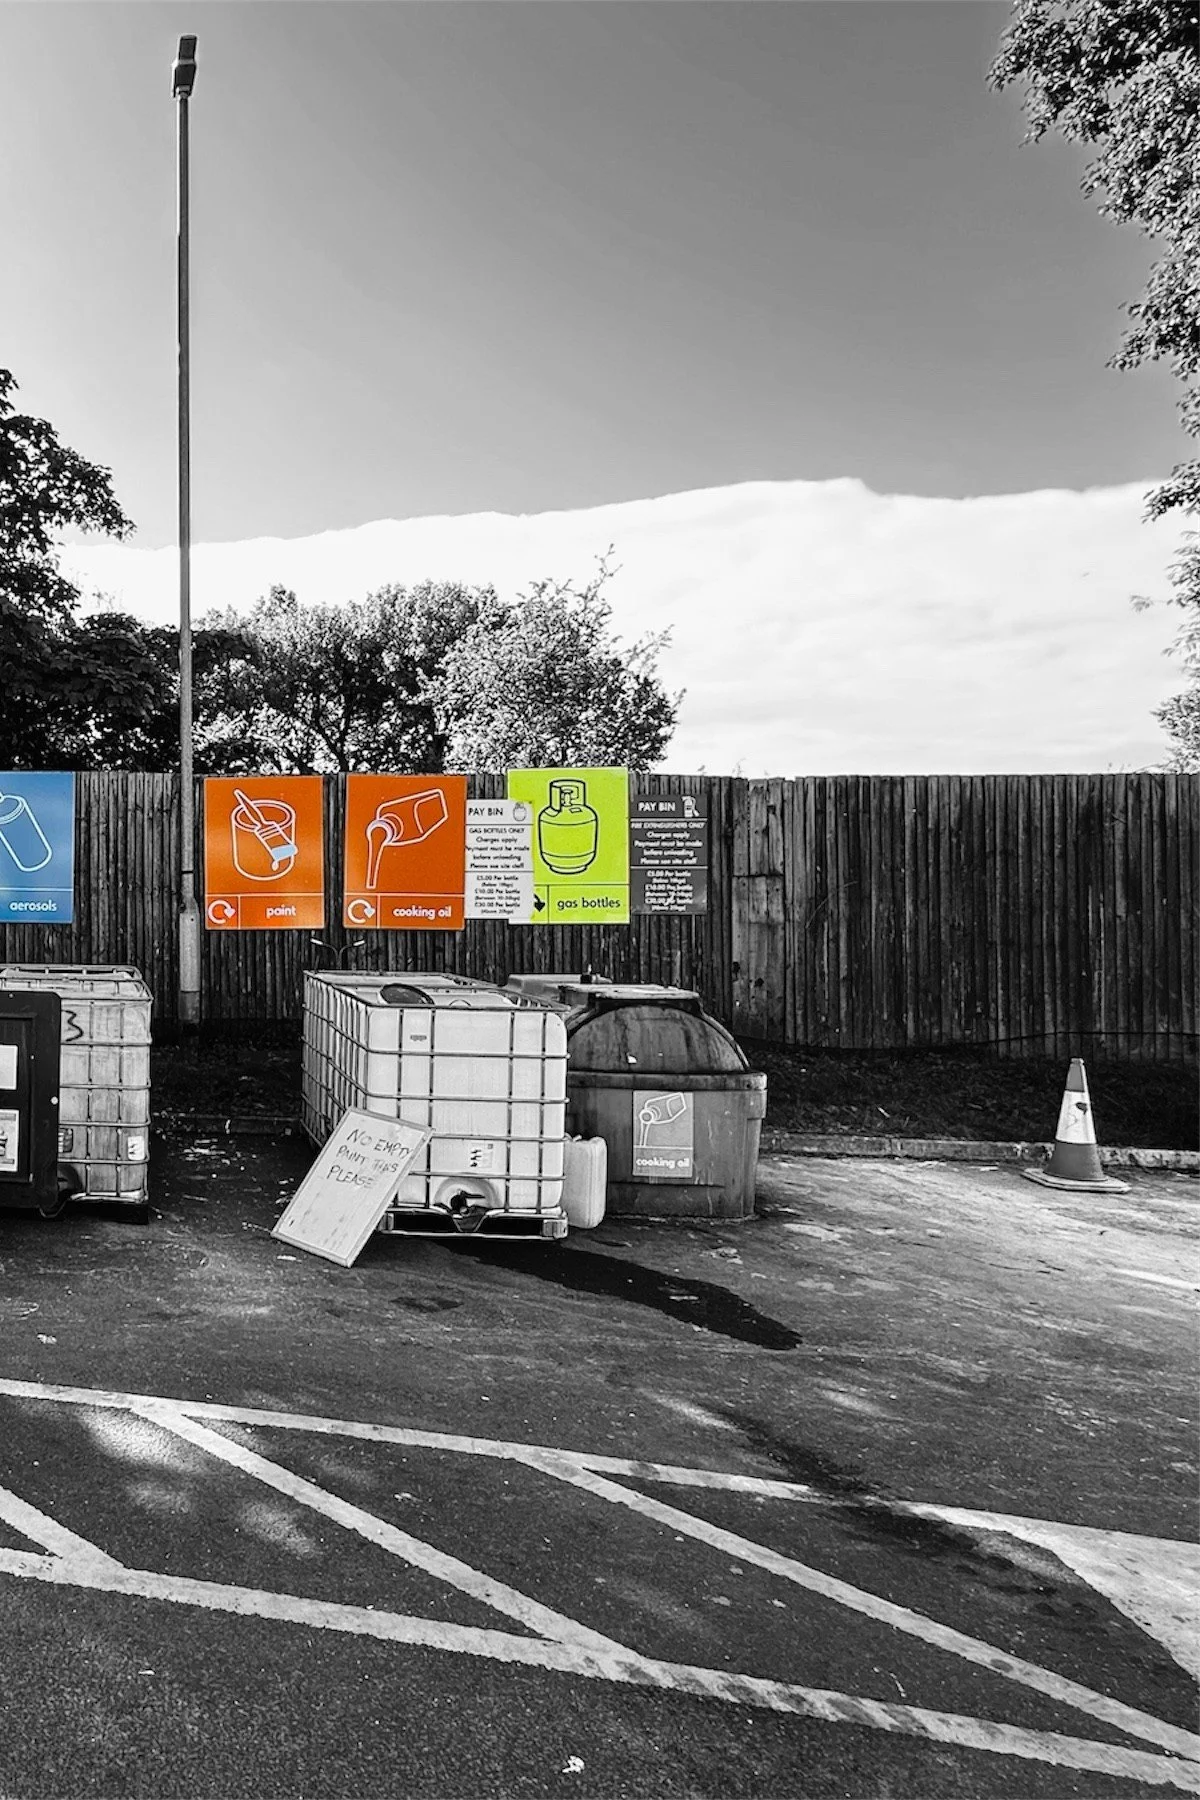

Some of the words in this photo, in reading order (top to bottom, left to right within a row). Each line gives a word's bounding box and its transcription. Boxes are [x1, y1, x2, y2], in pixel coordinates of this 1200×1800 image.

[468, 807, 485, 816] PAY
[487, 807, 504, 816] BIN
[638, 802, 657, 811] PAY
[658, 802, 676, 811] BIN
[476, 836, 500, 844] Charges
[501, 836, 517, 844] apply
[646, 831, 672, 840] Charges
[673, 831, 690, 839] apply
[634, 840, 660, 848] Payment
[643, 848, 663, 856] before
[663, 848, 694, 857] unloading
[9, 899, 57, 911] aerosols
[557, 900, 578, 911] gas
[582, 897, 621, 908] bottles
[266, 904, 297, 919] paint
[392, 904, 436, 920] cooking
[437, 905, 452, 917] oil
[346, 1128, 372, 1146] NO
[373, 1139, 414, 1160] EMPTY
[336, 1144, 367, 1165] PAINT
[636, 1157, 676, 1169] cooking
[677, 1158, 690, 1168] oil
[326, 1165, 375, 1189] PLEASE
